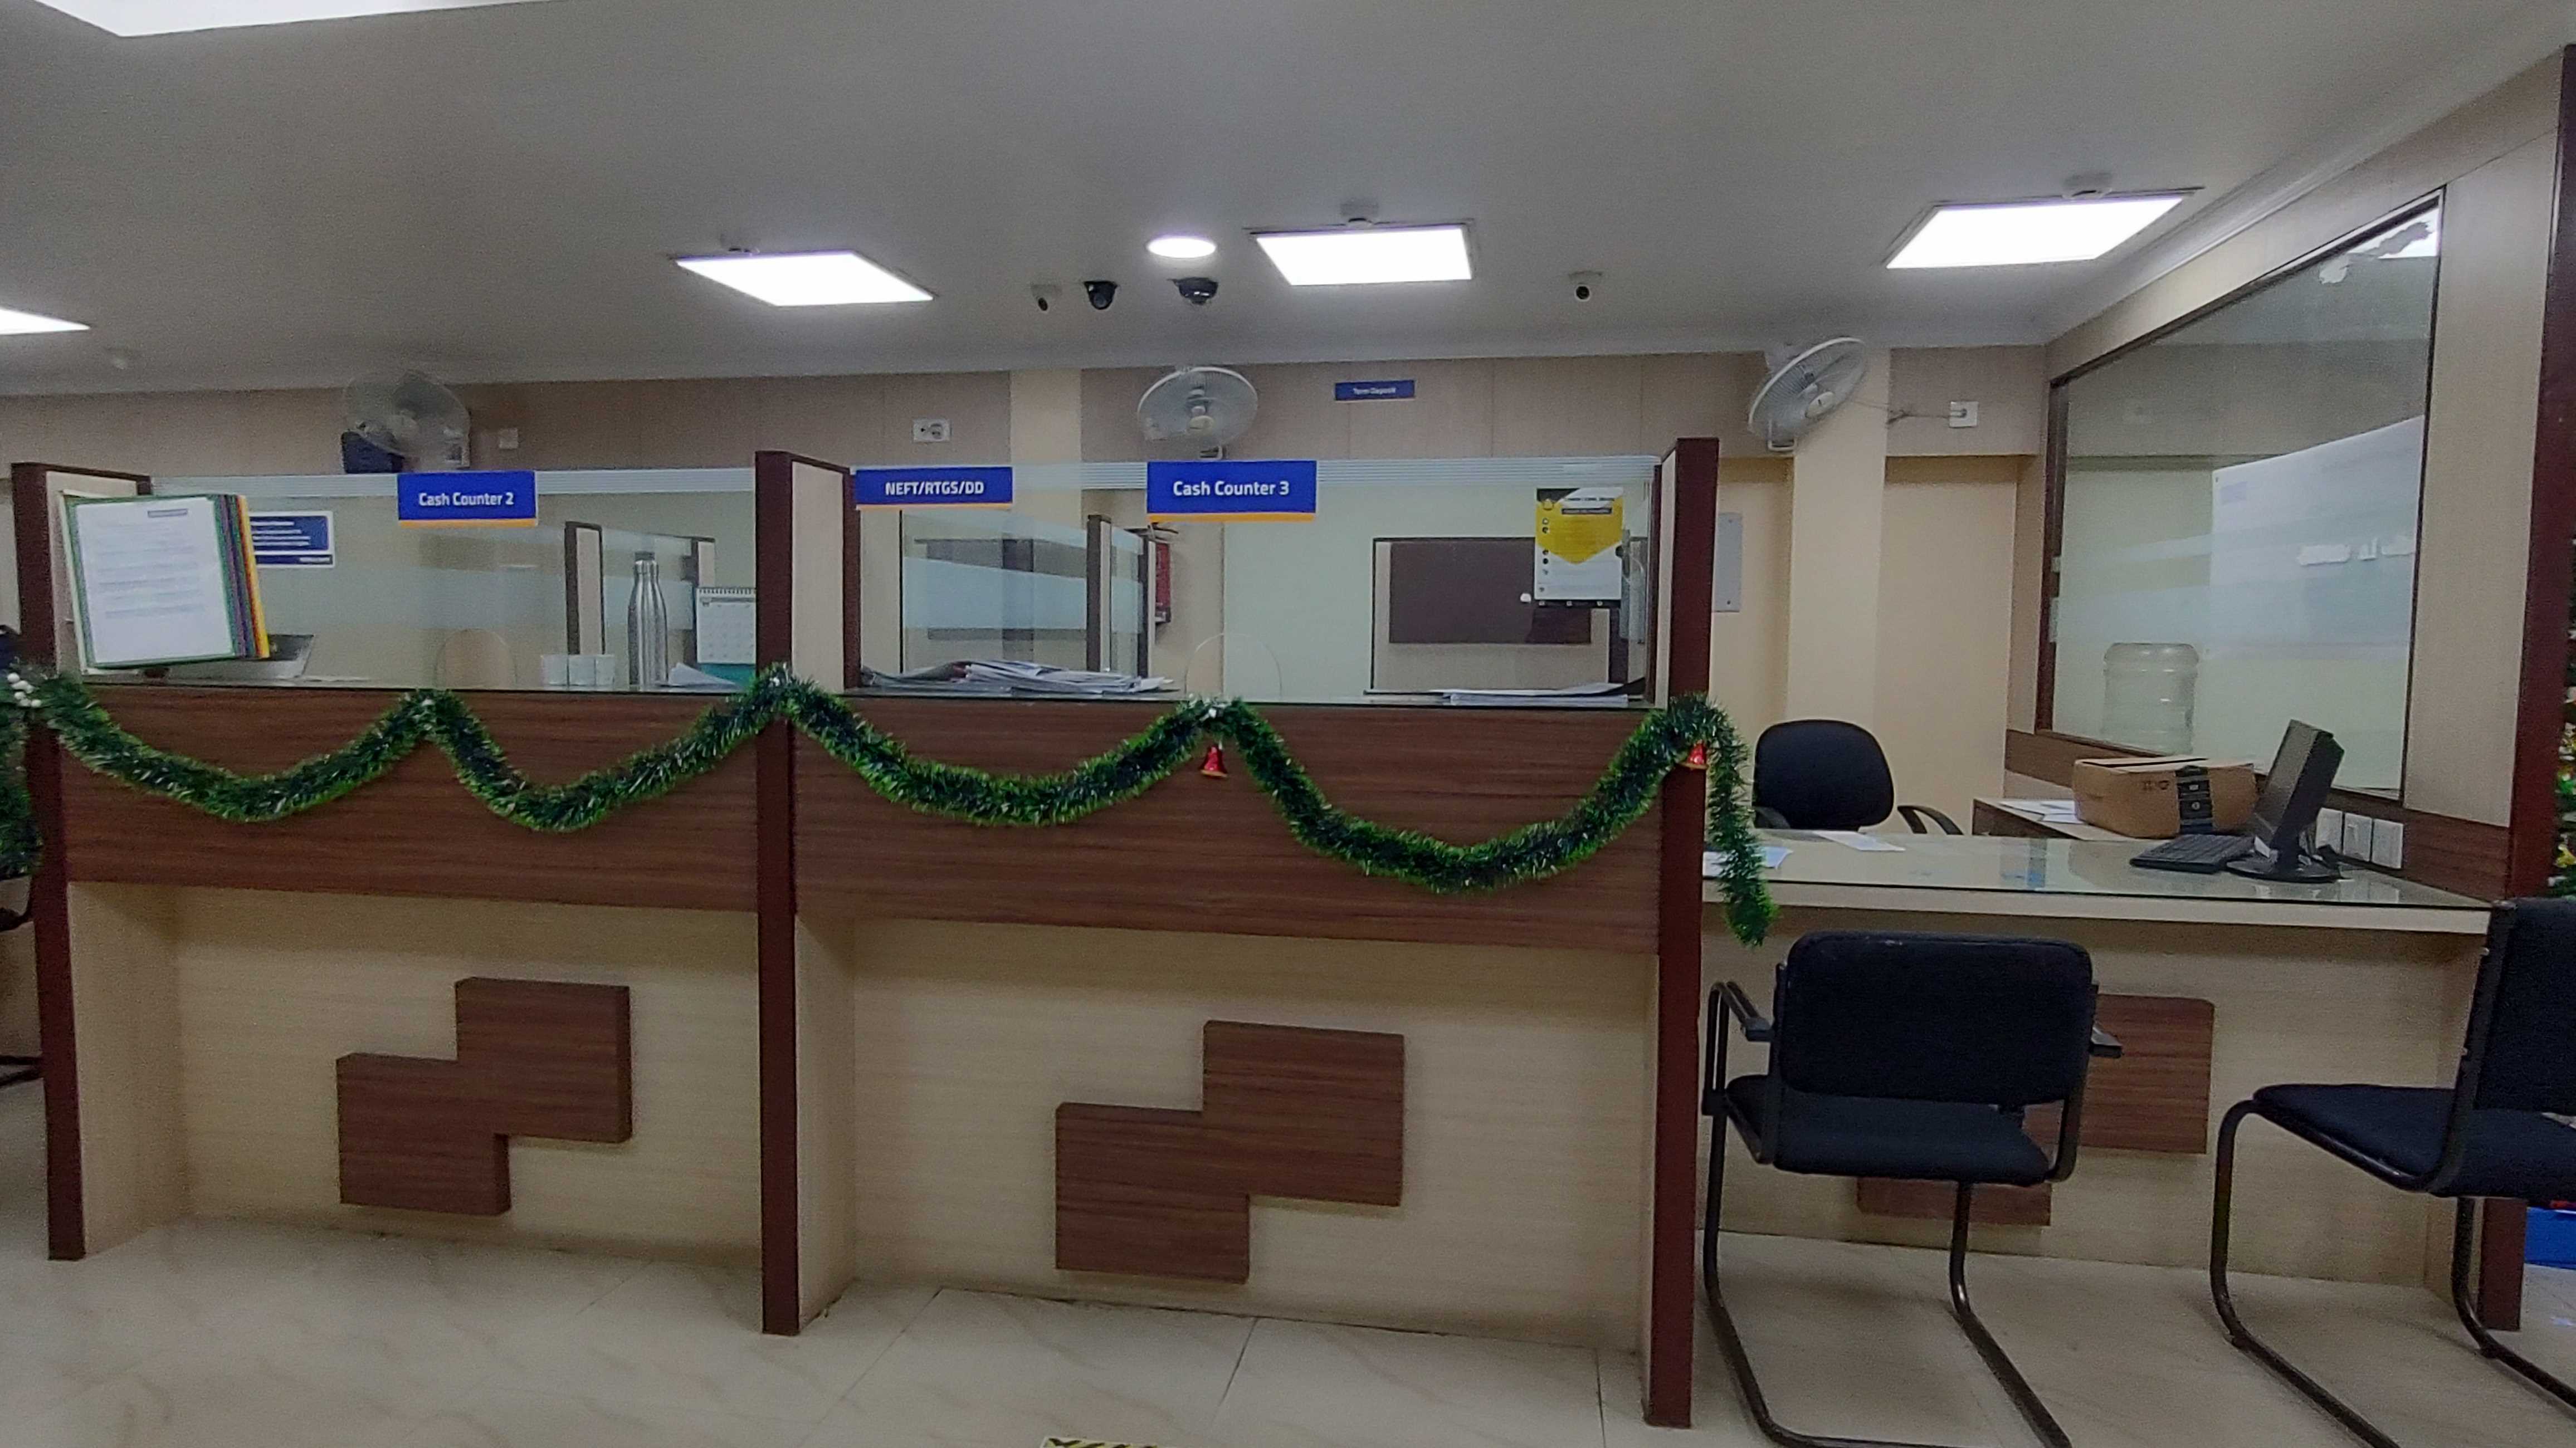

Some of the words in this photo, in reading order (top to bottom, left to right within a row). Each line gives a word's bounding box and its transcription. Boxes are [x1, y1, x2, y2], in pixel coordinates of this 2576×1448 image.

[885, 481, 985, 495] NEFT/RTGS/DD
[1173, 481, 1211, 496] Cash
[1214, 481, 1276, 496] Counter
[1279, 481, 1290, 496] 3
[418, 492, 450, 506] Cash
[452, 492, 502, 506] Counter
[505, 492, 514, 505] 2
